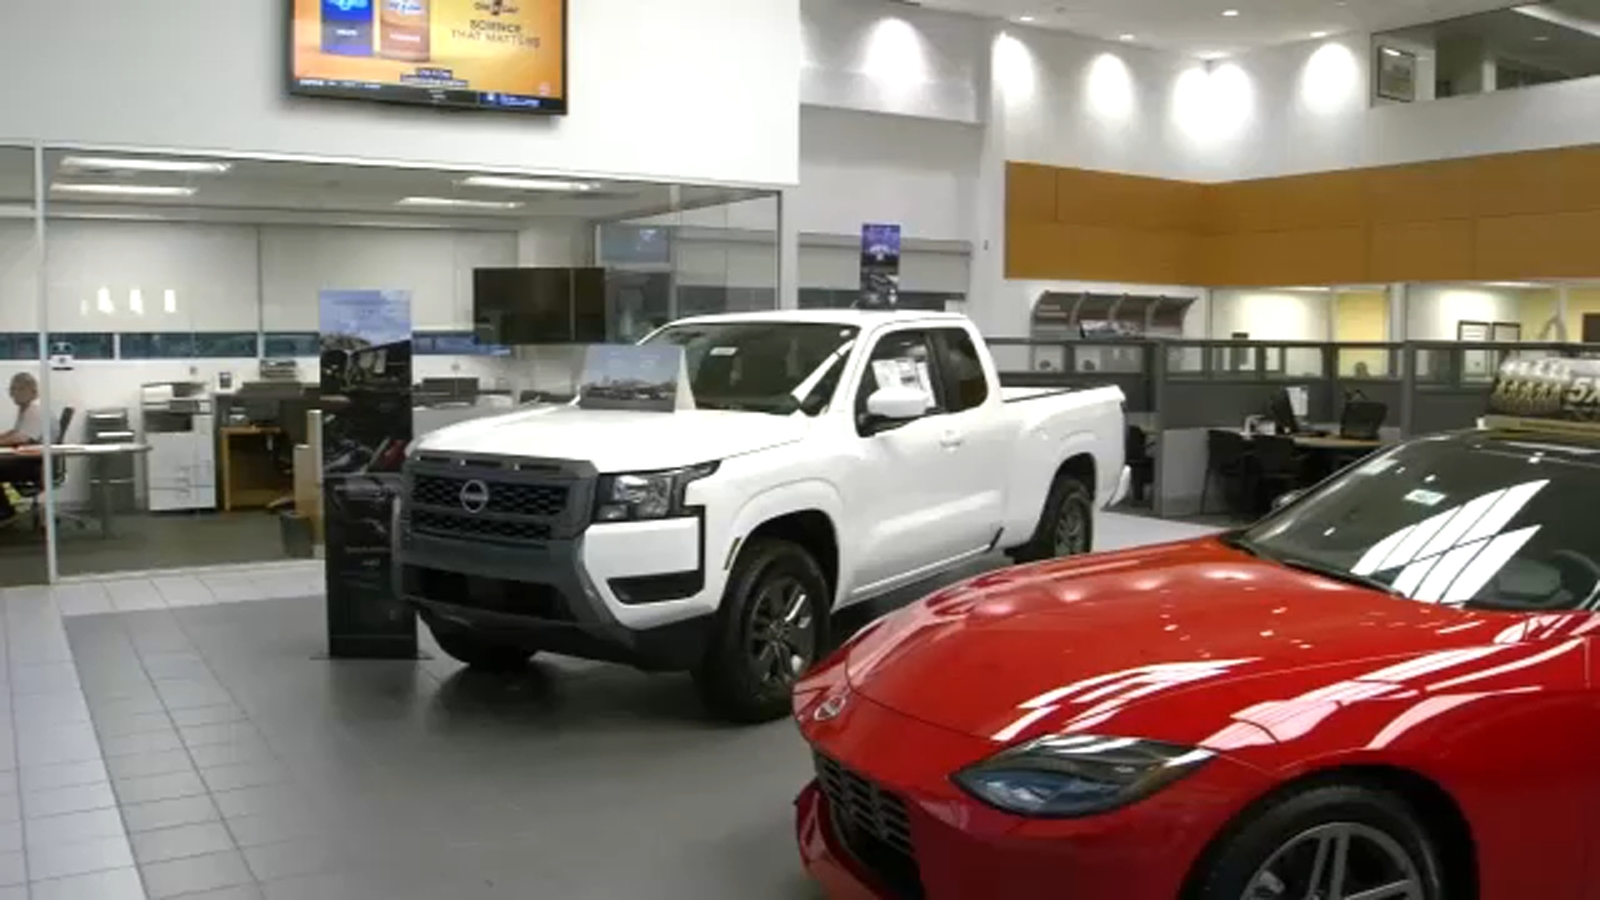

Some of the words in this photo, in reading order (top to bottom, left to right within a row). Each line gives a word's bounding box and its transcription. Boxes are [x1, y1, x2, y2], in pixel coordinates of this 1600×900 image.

[469, 19, 522, 34] SCIENCE
[451, 28, 482, 41] THAT
[485, 31, 541, 49] MATTERS
